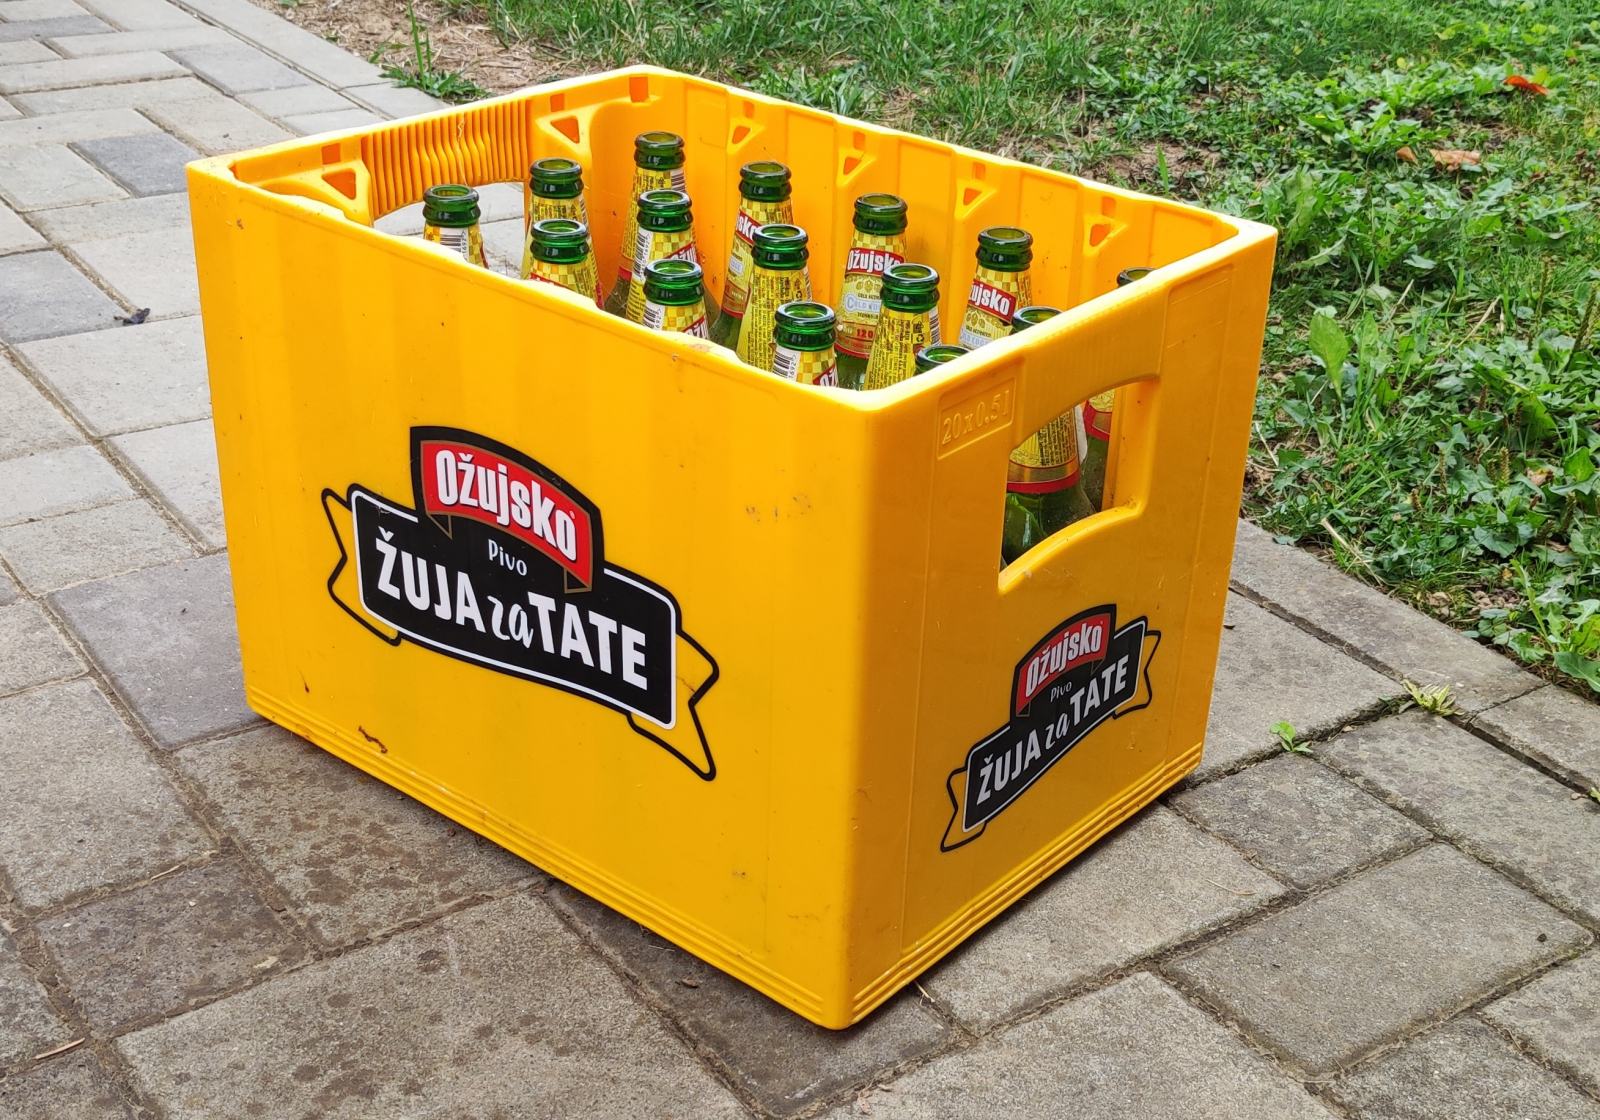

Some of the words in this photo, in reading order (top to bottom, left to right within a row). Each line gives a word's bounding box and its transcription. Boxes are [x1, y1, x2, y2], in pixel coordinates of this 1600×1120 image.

[969, 283, 1010, 316] ujsko
[435, 449, 577, 561] Ožujsko
[488, 538, 528, 577] Pivo
[375, 525, 485, 633] ŽUJA
[488, 594, 534, 649] za
[527, 591, 648, 691] TATE
[1025, 623, 1103, 698] Ožujsko
[1050, 681, 1073, 702] Pivo
[976, 729, 1042, 806] ŽUJA
[1045, 712, 1070, 750] za
[1069, 654, 1129, 727] TATE
